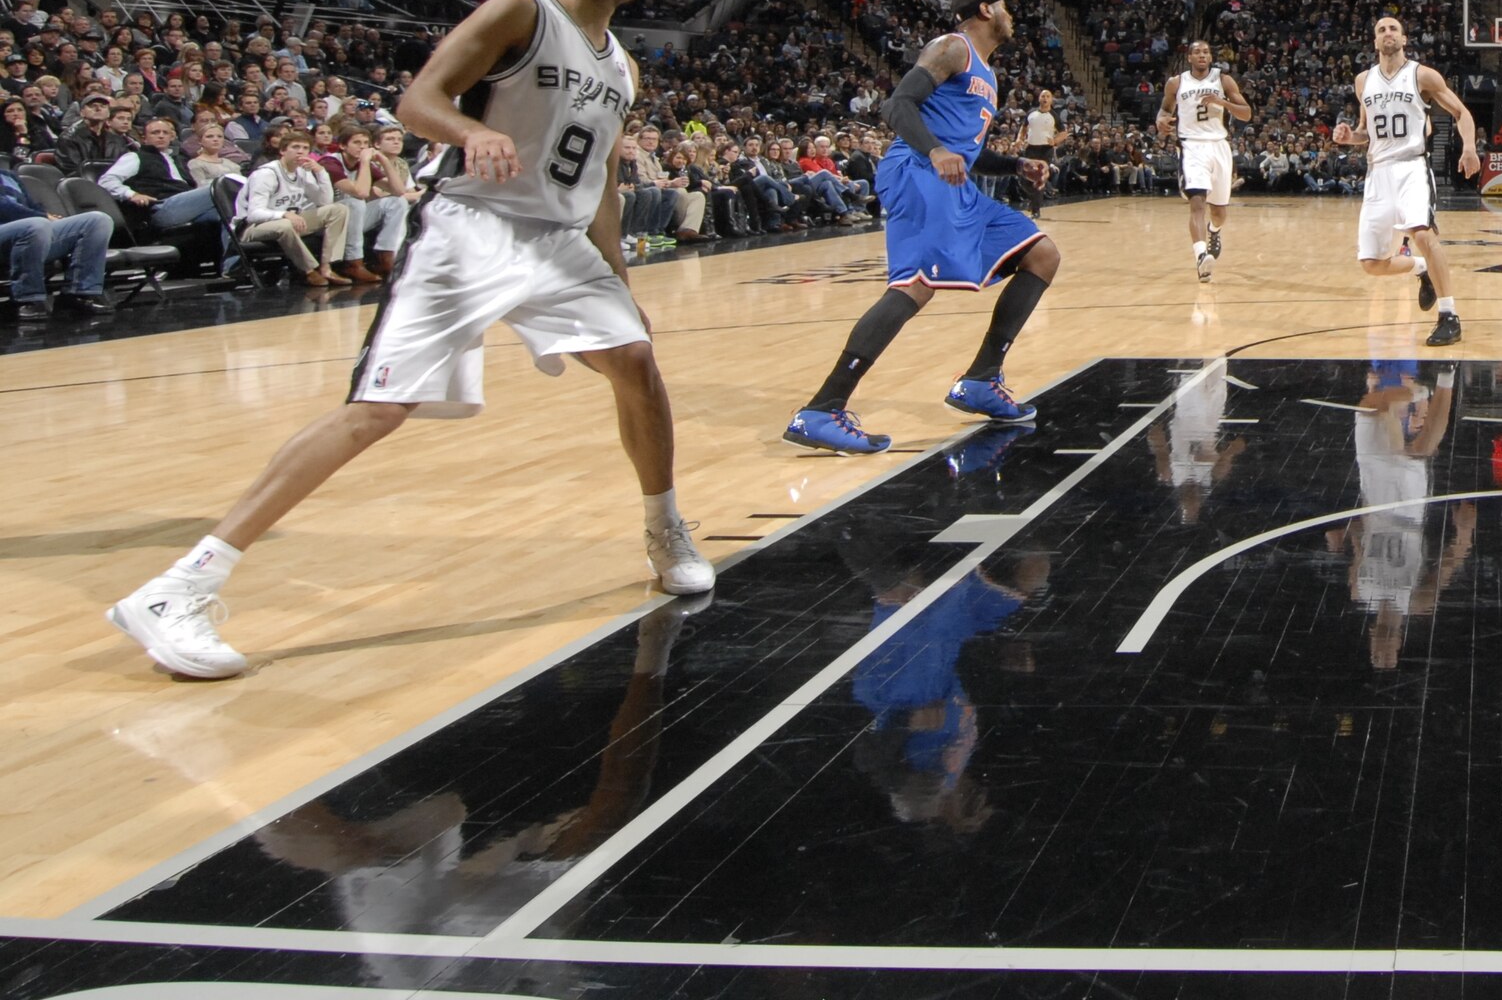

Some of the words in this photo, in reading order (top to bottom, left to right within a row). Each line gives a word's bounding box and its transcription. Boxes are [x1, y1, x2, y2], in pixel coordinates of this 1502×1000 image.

[537, 65, 630, 123] SPURS
[1181, 88, 1221, 101] SPURS
[1365, 91, 1414, 107] SPURS
[974, 107, 993, 145] 7
[1196, 104, 1208, 122] 2
[1374, 113, 1407, 139] 20
[549, 122, 597, 190] 9
